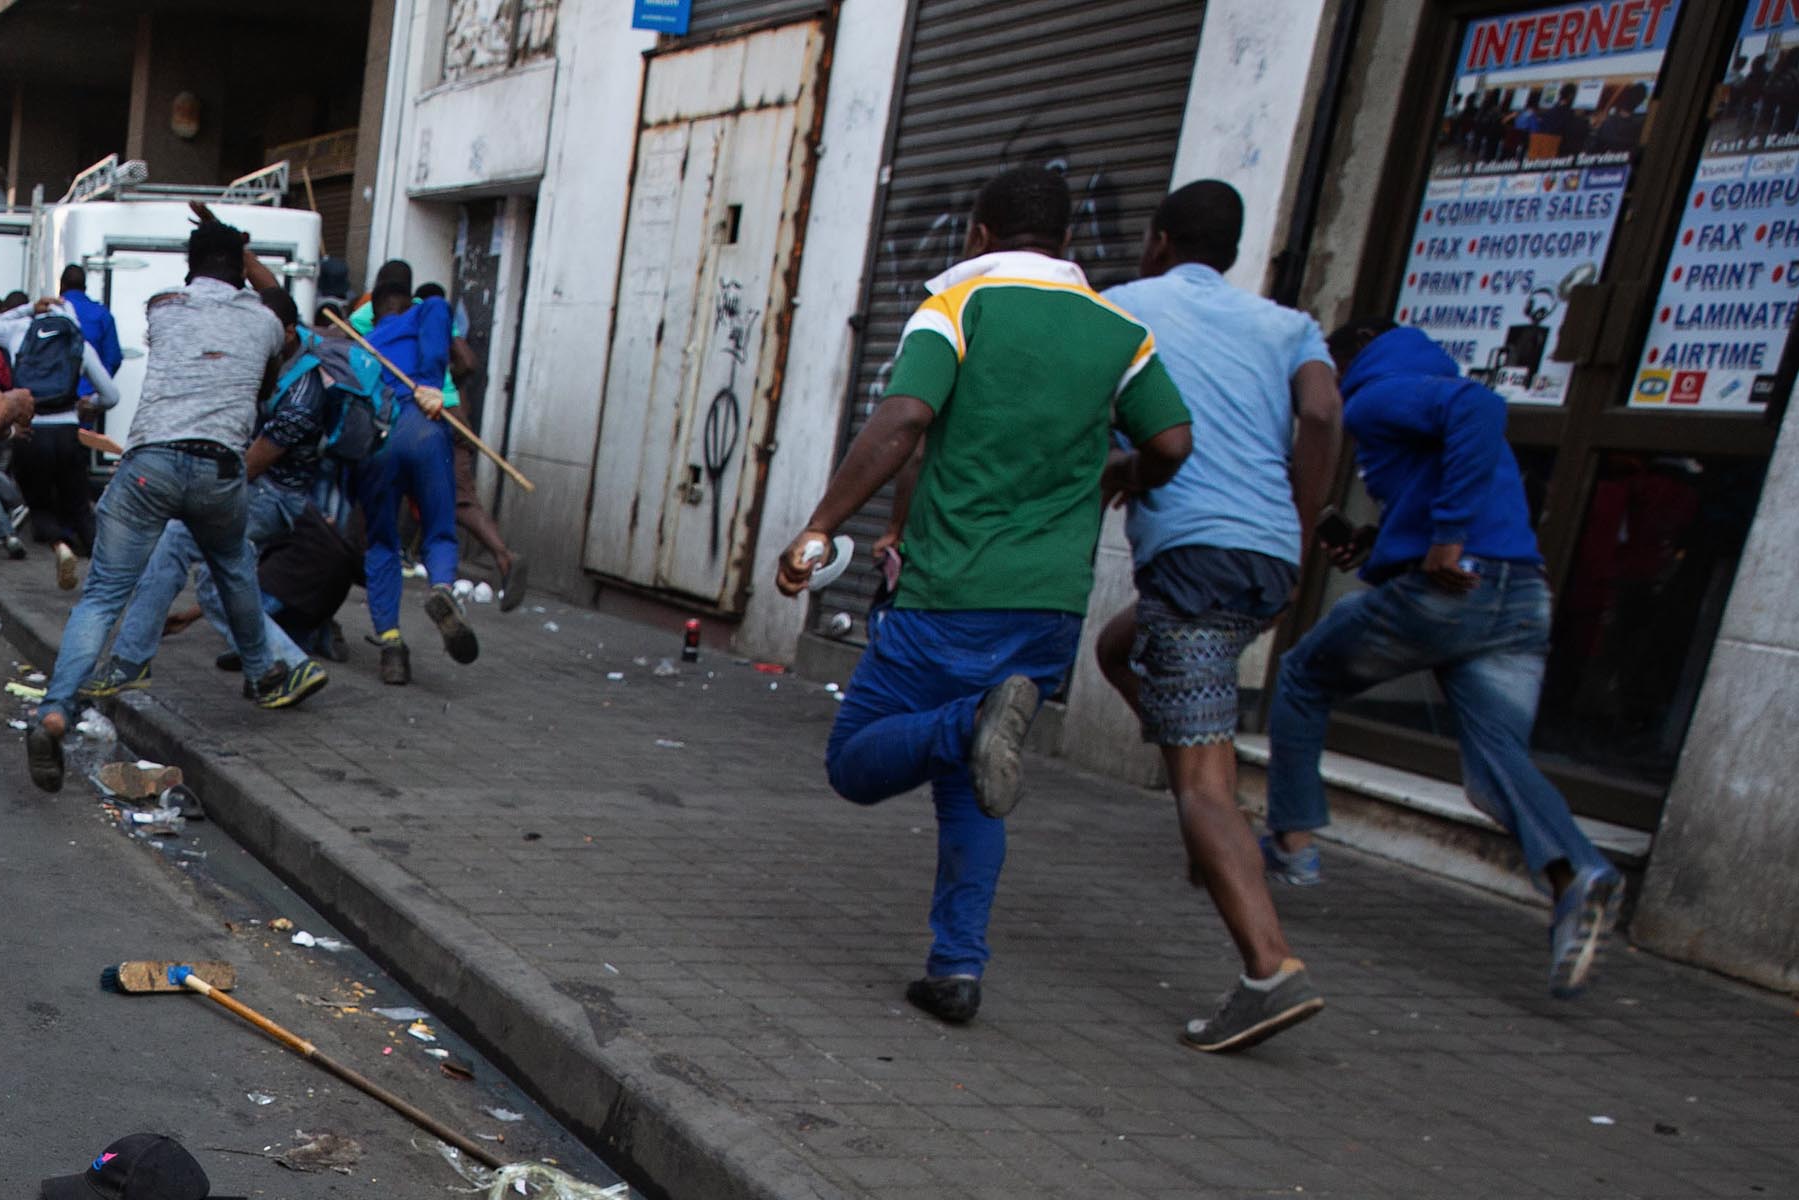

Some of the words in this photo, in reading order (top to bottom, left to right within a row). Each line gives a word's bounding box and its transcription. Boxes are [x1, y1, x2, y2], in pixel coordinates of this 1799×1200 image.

[1466, 1, 1672, 70] INTERNET
[1434, 198, 1542, 226] COMPUTER
[1546, 192, 1615, 219] SALES
[1426, 237, 1463, 260] FAX
[1477, 230, 1603, 258] PHOTOCOPY
[1697, 222, 1748, 250] FAX
[1416, 270, 1475, 295] PRINT
[1489, 269, 1536, 294] CV'S
[1685, 261, 1764, 290] PRINT
[1408, 305, 1504, 329] LAMINATE
[1662, 342, 1768, 369] AIRTIME
